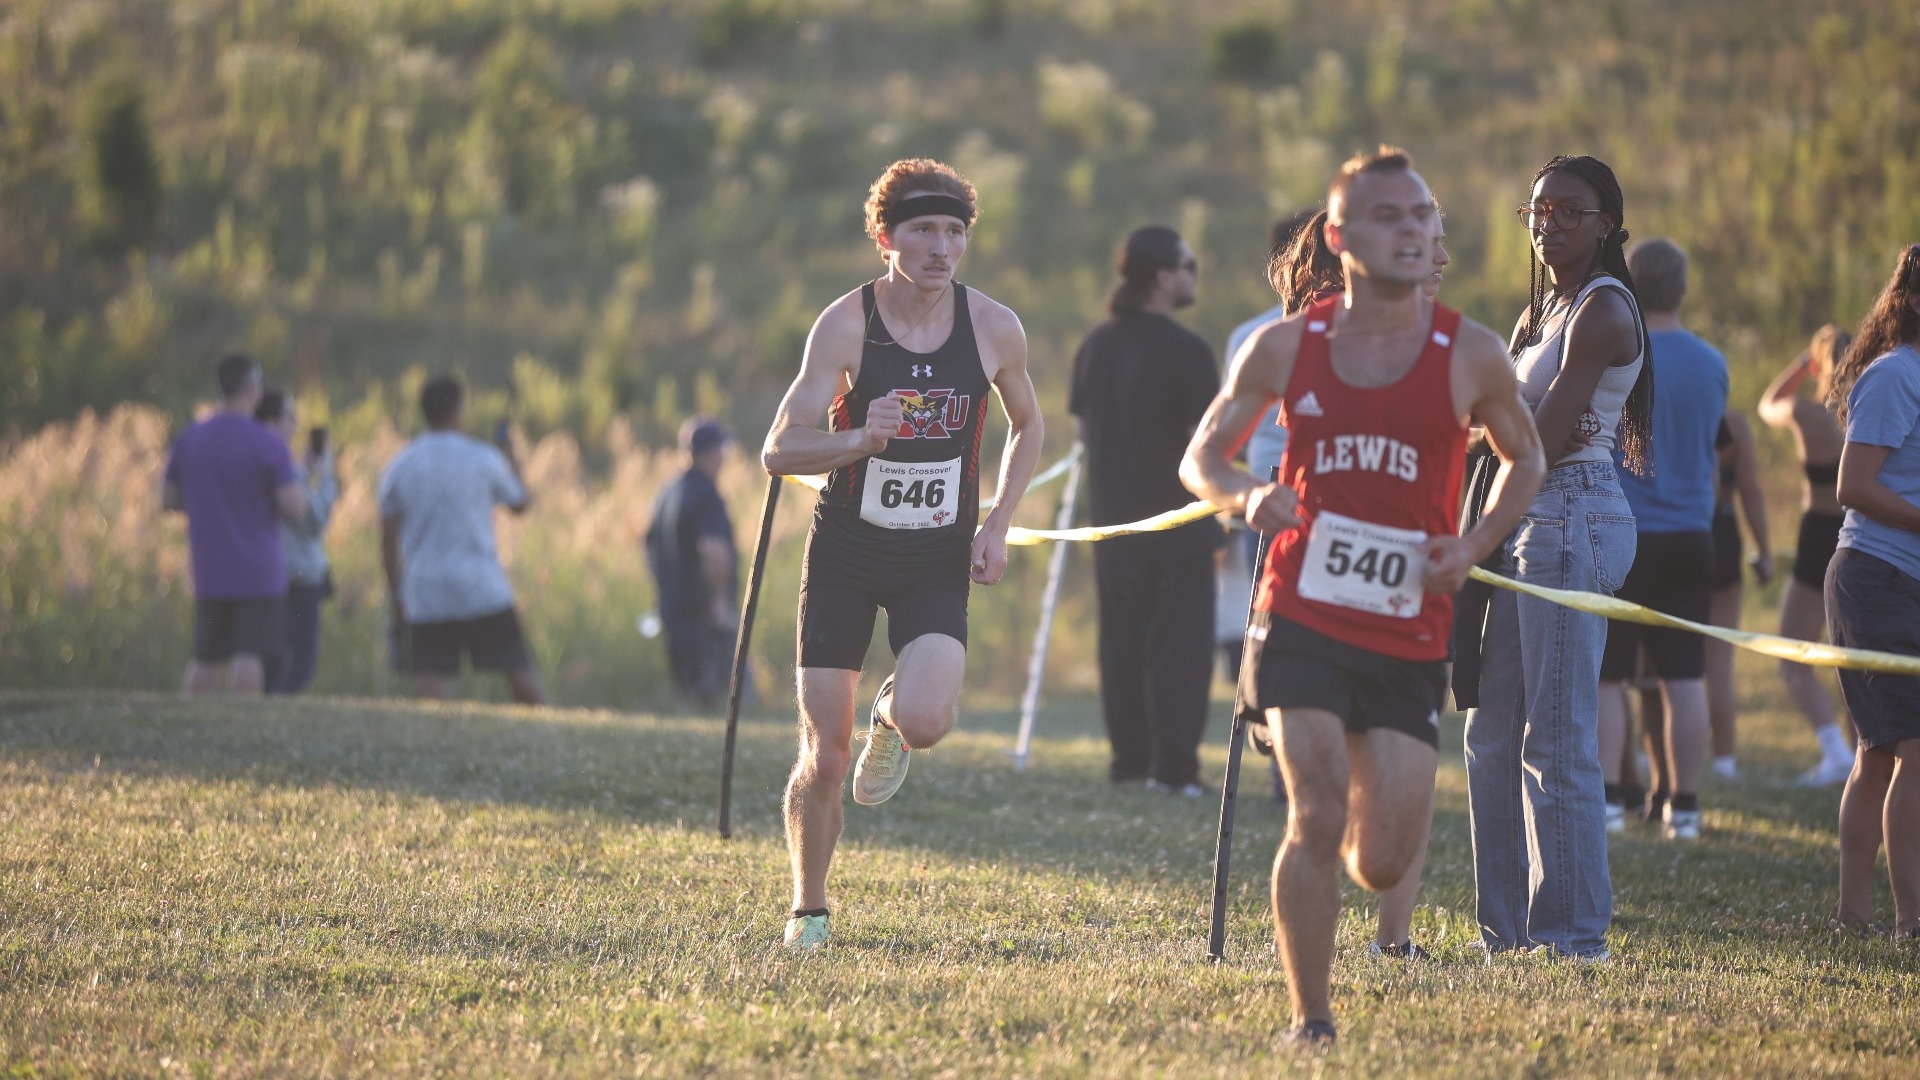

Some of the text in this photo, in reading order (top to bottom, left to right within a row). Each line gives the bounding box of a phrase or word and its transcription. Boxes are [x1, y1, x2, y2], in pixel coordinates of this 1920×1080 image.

[880, 465, 952, 475] Lewis Crossover
[1315, 434, 1418, 482] LEWIS
[881, 479, 946, 509] 646
[1325, 539, 1408, 588] 540
